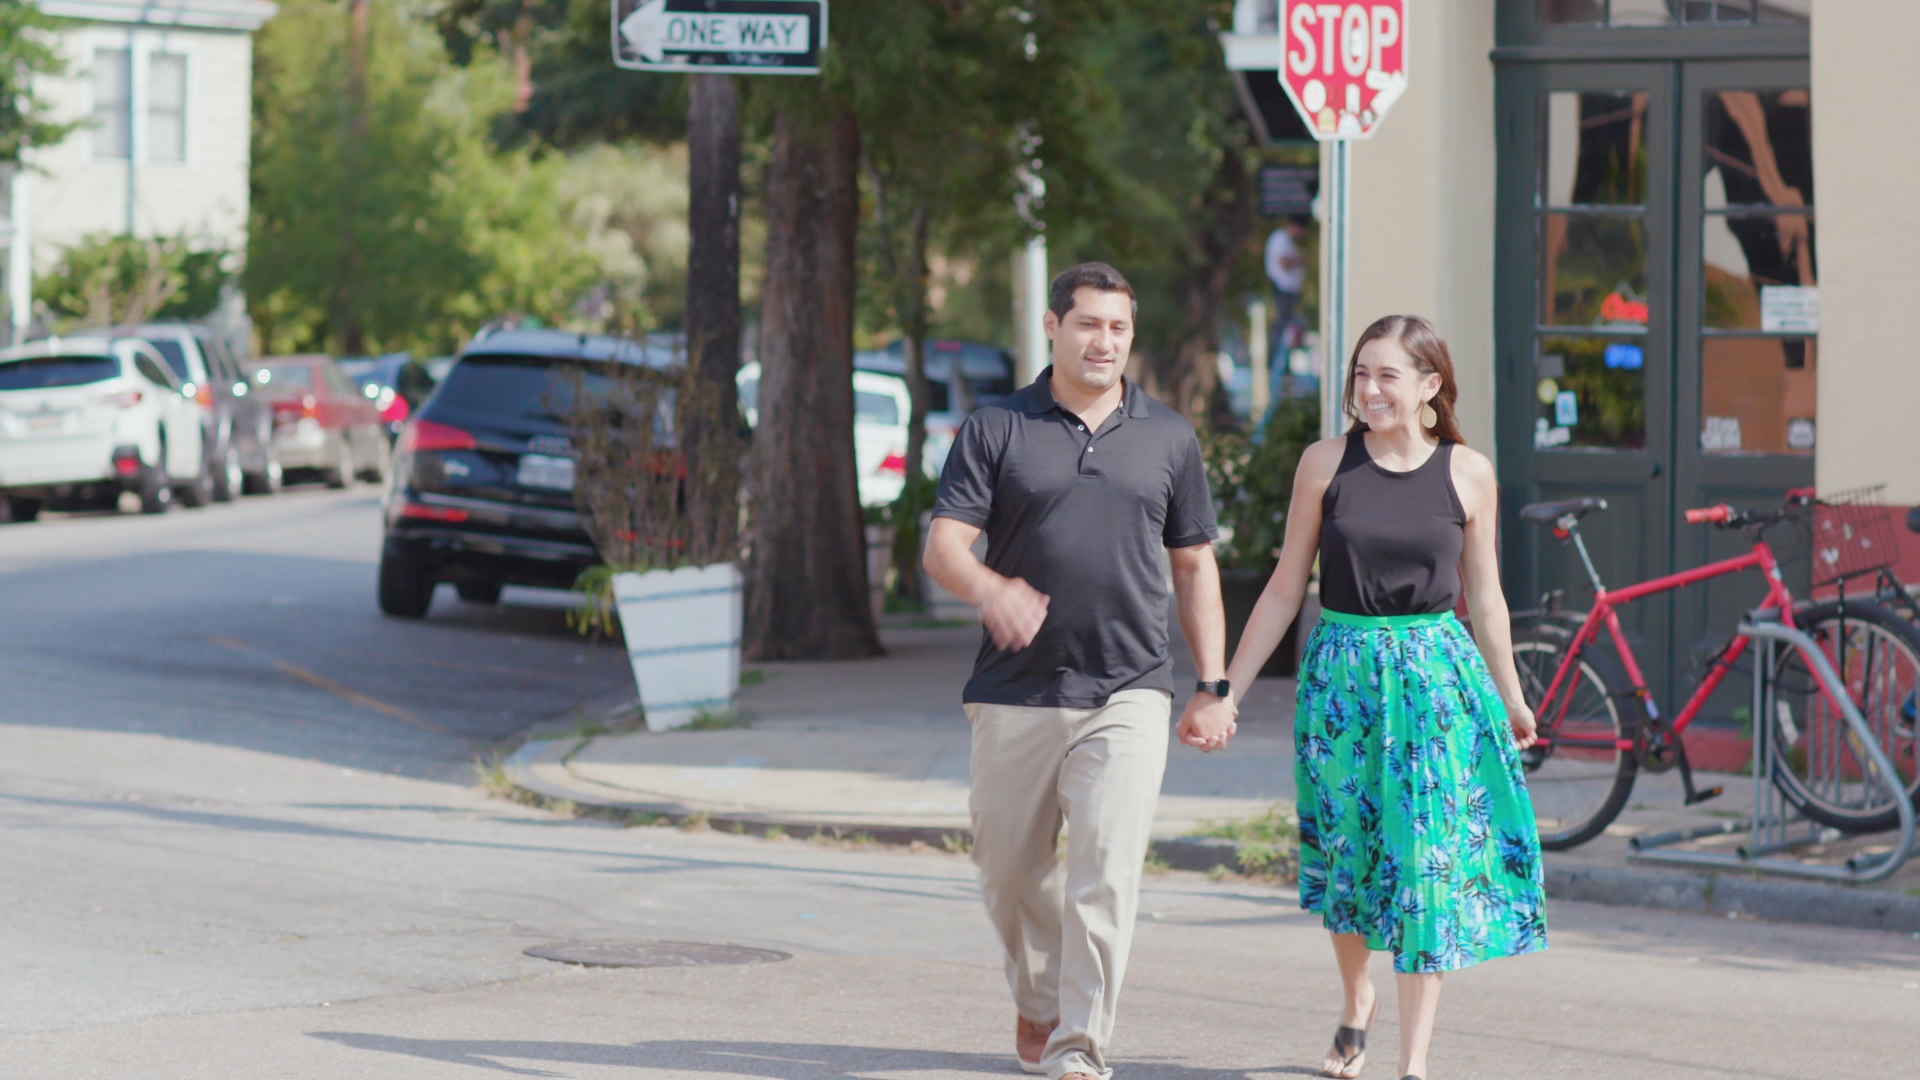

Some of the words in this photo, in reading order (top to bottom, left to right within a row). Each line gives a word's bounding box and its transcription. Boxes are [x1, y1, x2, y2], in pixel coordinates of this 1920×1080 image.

[667, 17, 725, 46] ONE
[737, 18, 798, 46] WAY
[1288, 3, 1399, 76] STOP
